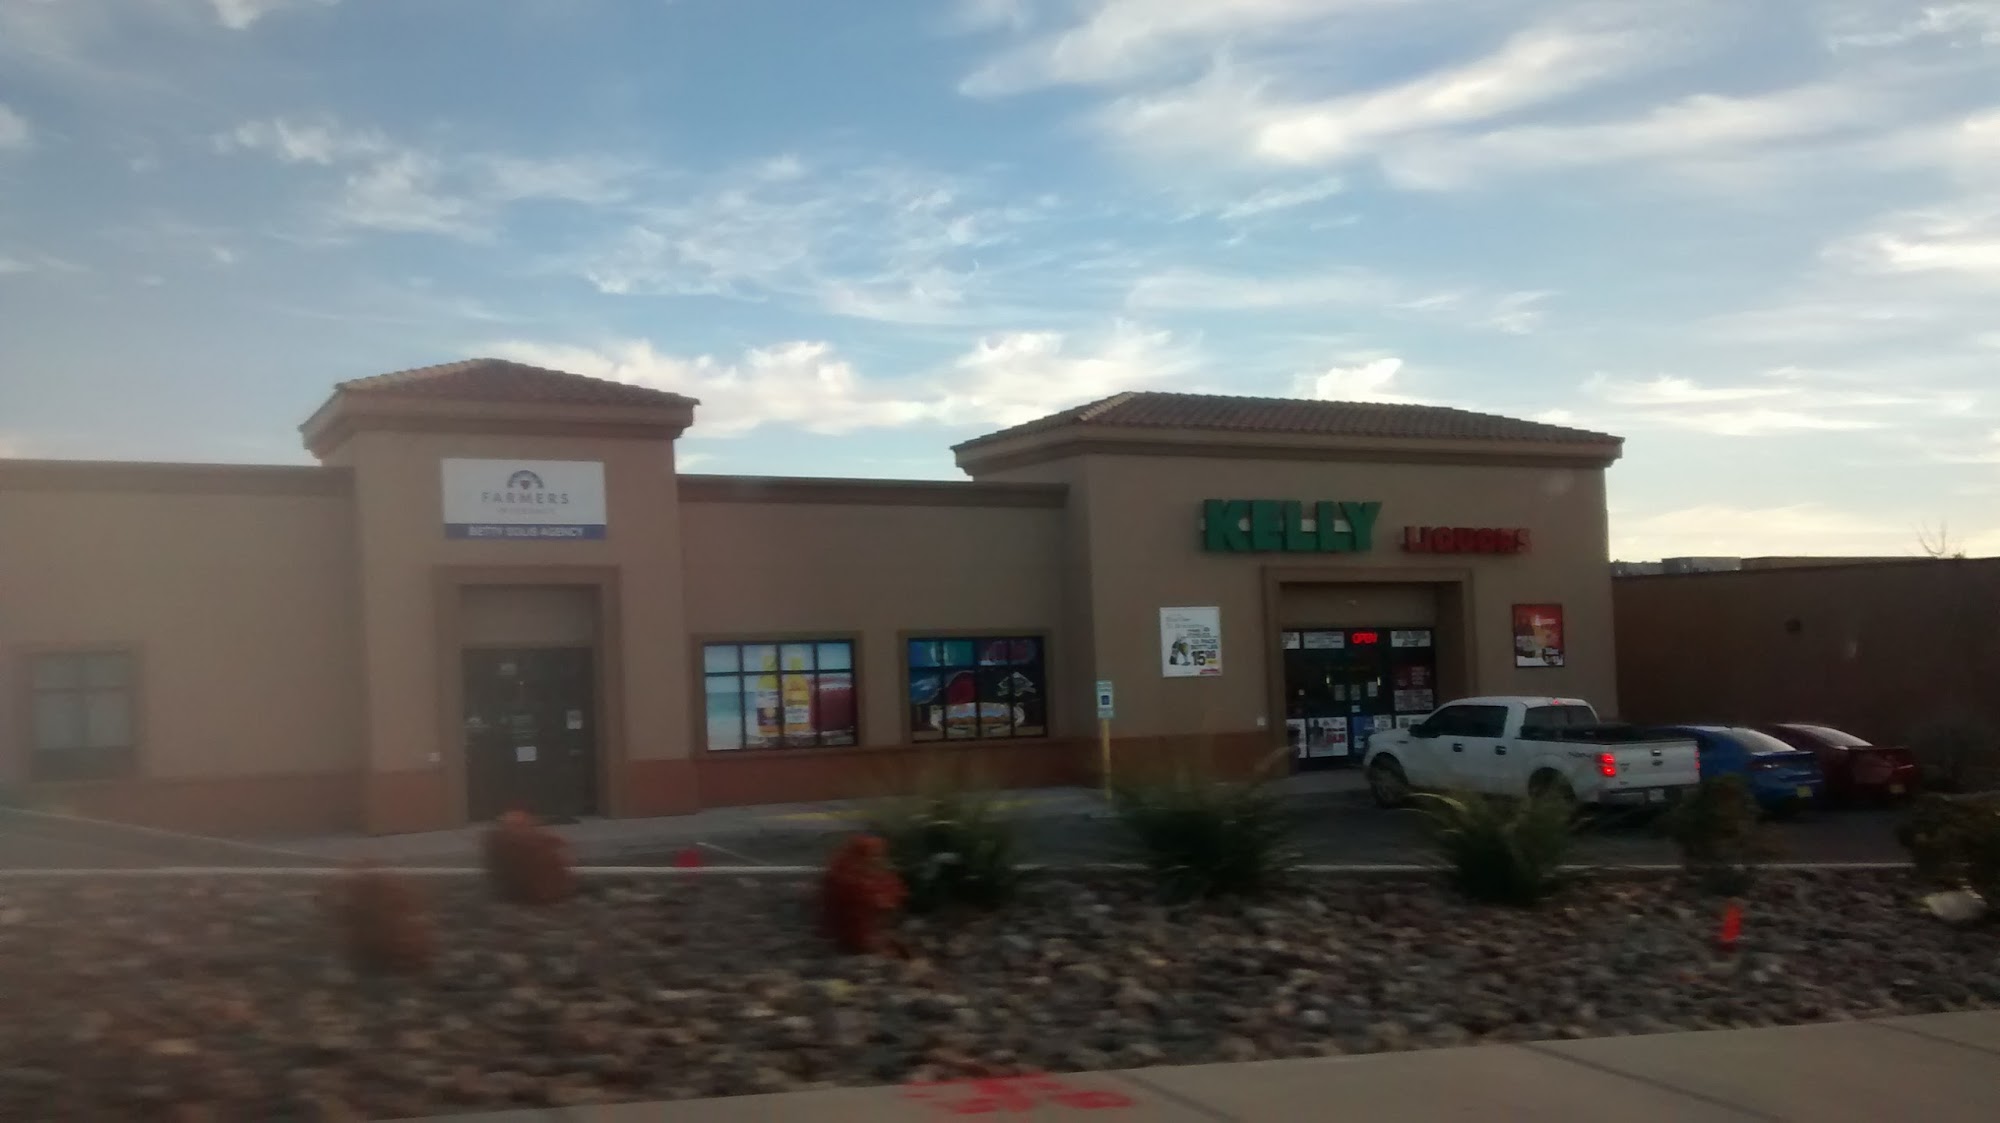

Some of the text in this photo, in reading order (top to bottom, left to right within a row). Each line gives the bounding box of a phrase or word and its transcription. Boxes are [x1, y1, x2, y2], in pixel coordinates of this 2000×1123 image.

[481, 491, 569, 504] FARMERS
[540, 526, 583, 537] AGENCY
[1204, 499, 1531, 553] KELLY LIQUORS
[1352, 632, 1378, 644] OPEN
